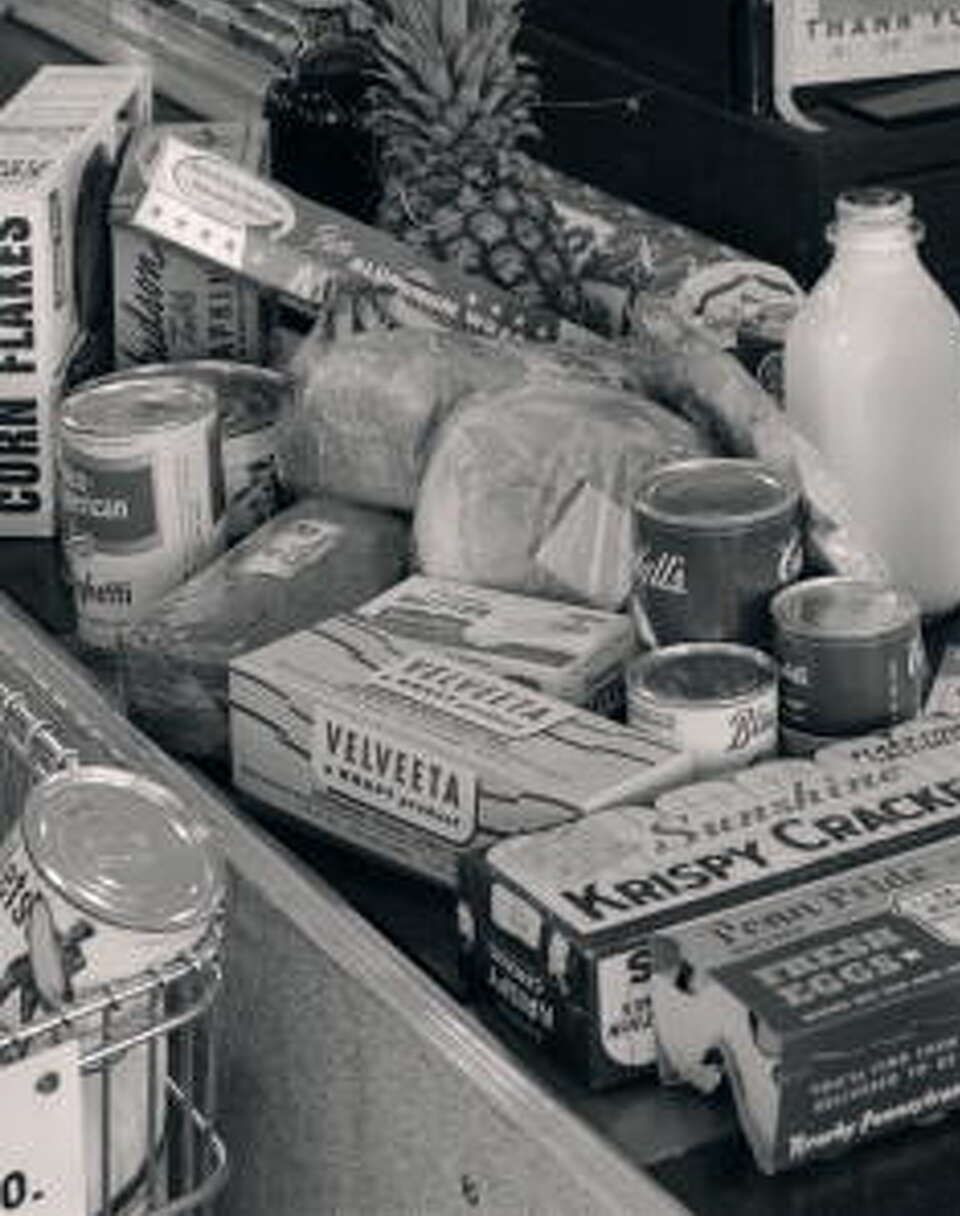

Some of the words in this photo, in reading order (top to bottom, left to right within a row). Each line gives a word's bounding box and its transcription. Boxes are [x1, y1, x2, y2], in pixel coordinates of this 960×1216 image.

[806, 14, 912, 39] THANK
[0, 217, 36, 373] FLAKES
[0, 394, 42, 513] CORN
[325, 720, 461, 808] VELVEETA
[558, 839, 769, 922] KRISPY
